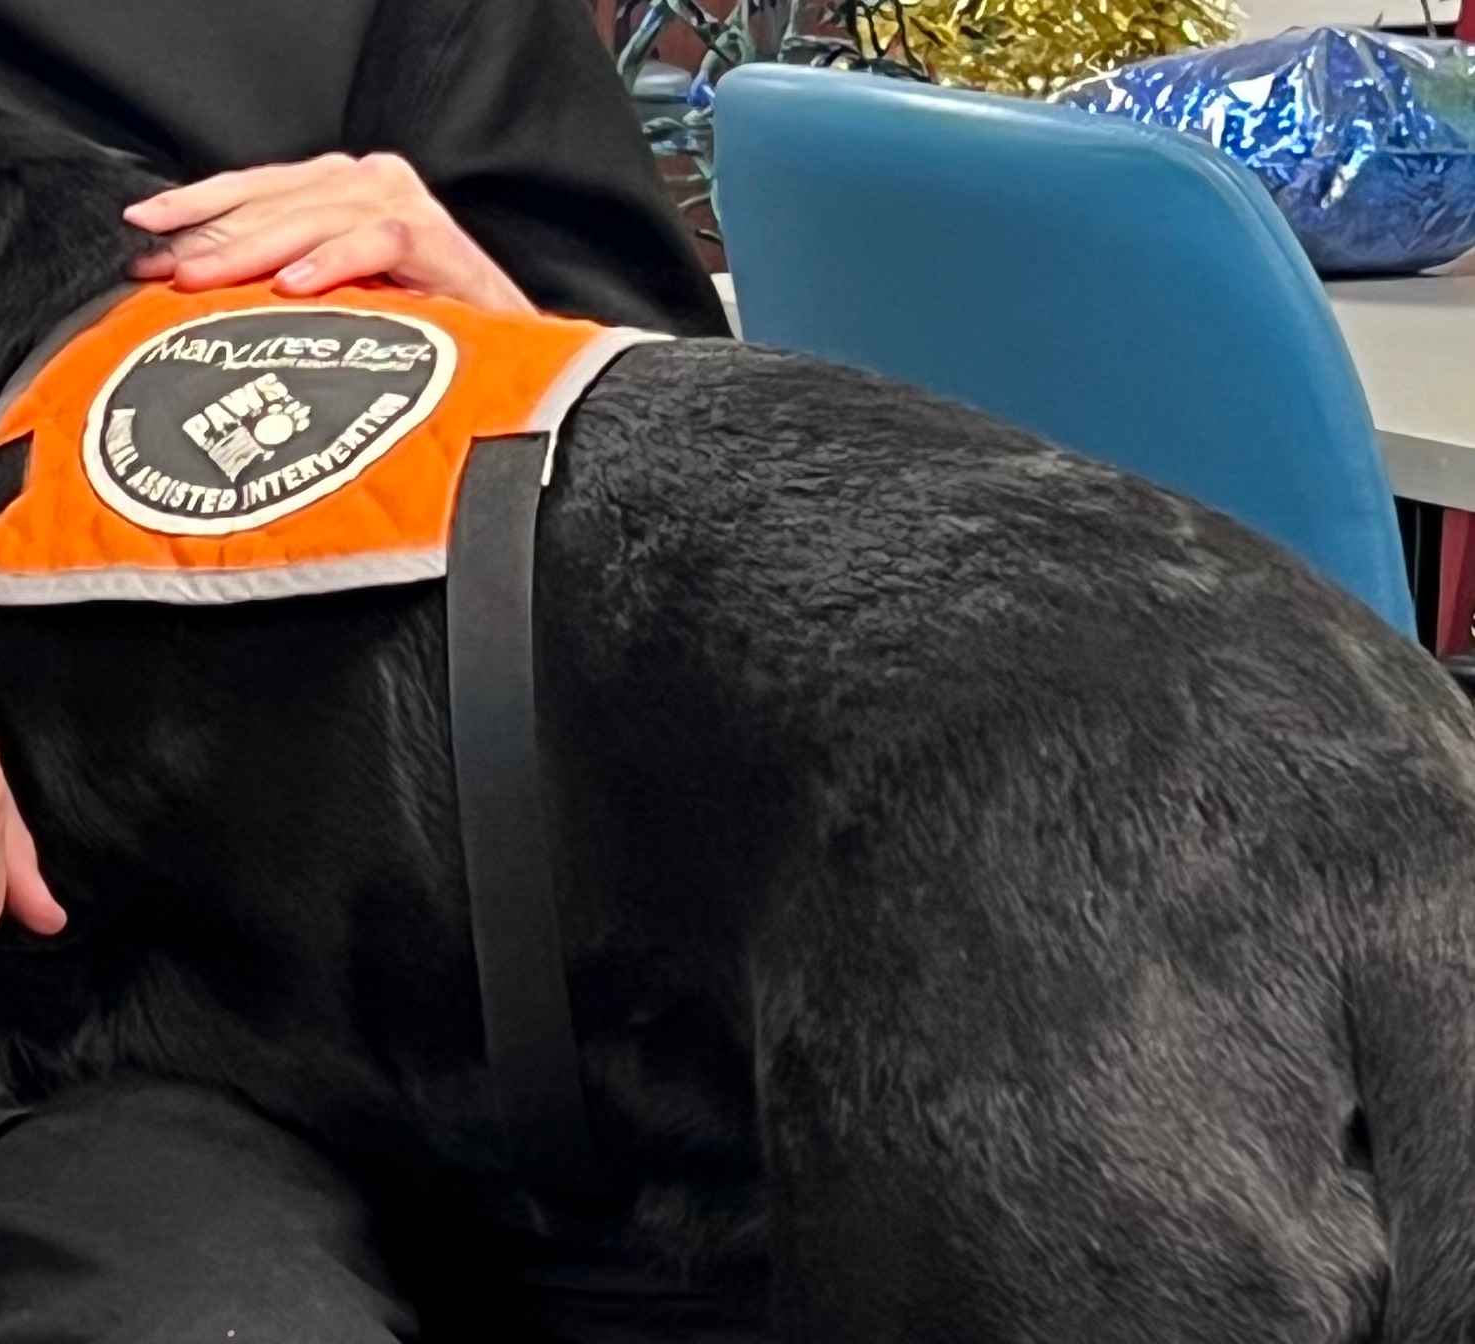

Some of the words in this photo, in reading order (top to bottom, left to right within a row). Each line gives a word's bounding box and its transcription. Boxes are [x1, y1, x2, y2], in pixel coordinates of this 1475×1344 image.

[144, 336, 252, 370] Mary
[181, 371, 288, 451] PAWS
[126, 466, 237, 514] ASSISTED
